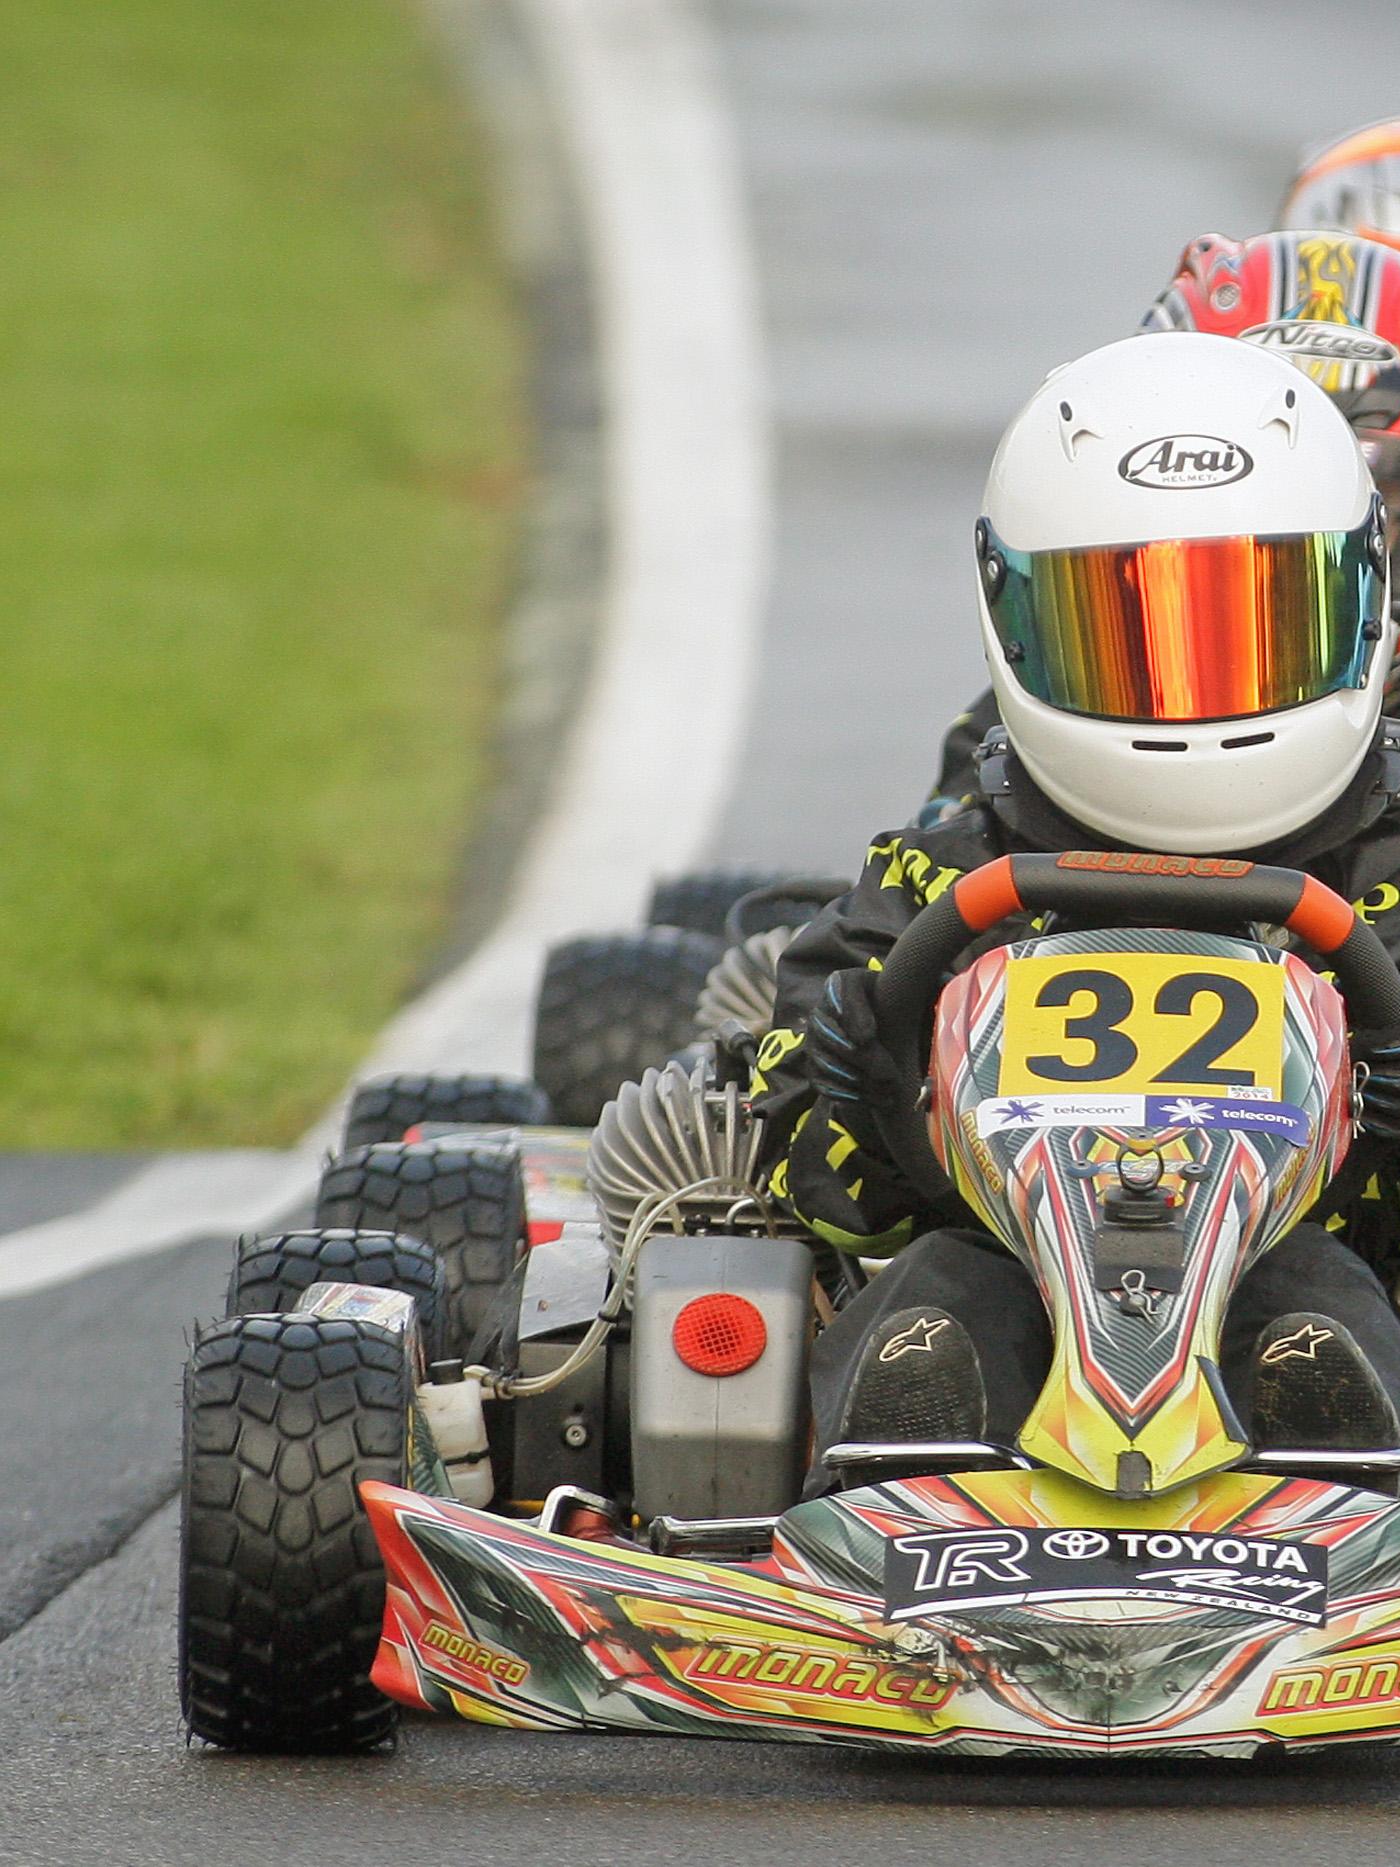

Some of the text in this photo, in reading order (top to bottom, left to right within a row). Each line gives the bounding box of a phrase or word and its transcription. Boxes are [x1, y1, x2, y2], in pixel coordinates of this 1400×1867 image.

[1262, 325, 1377, 354] Nitro
[1128, 441, 1239, 477] Arai
[1025, 969, 1259, 1086] 32
[1118, 1533, 1308, 1573] TOYOTA
[1125, 1590, 1310, 1619] NEW ZEALAND
[1136, 1568, 1326, 1605] Racing
[426, 1624, 527, 1684] monaco
